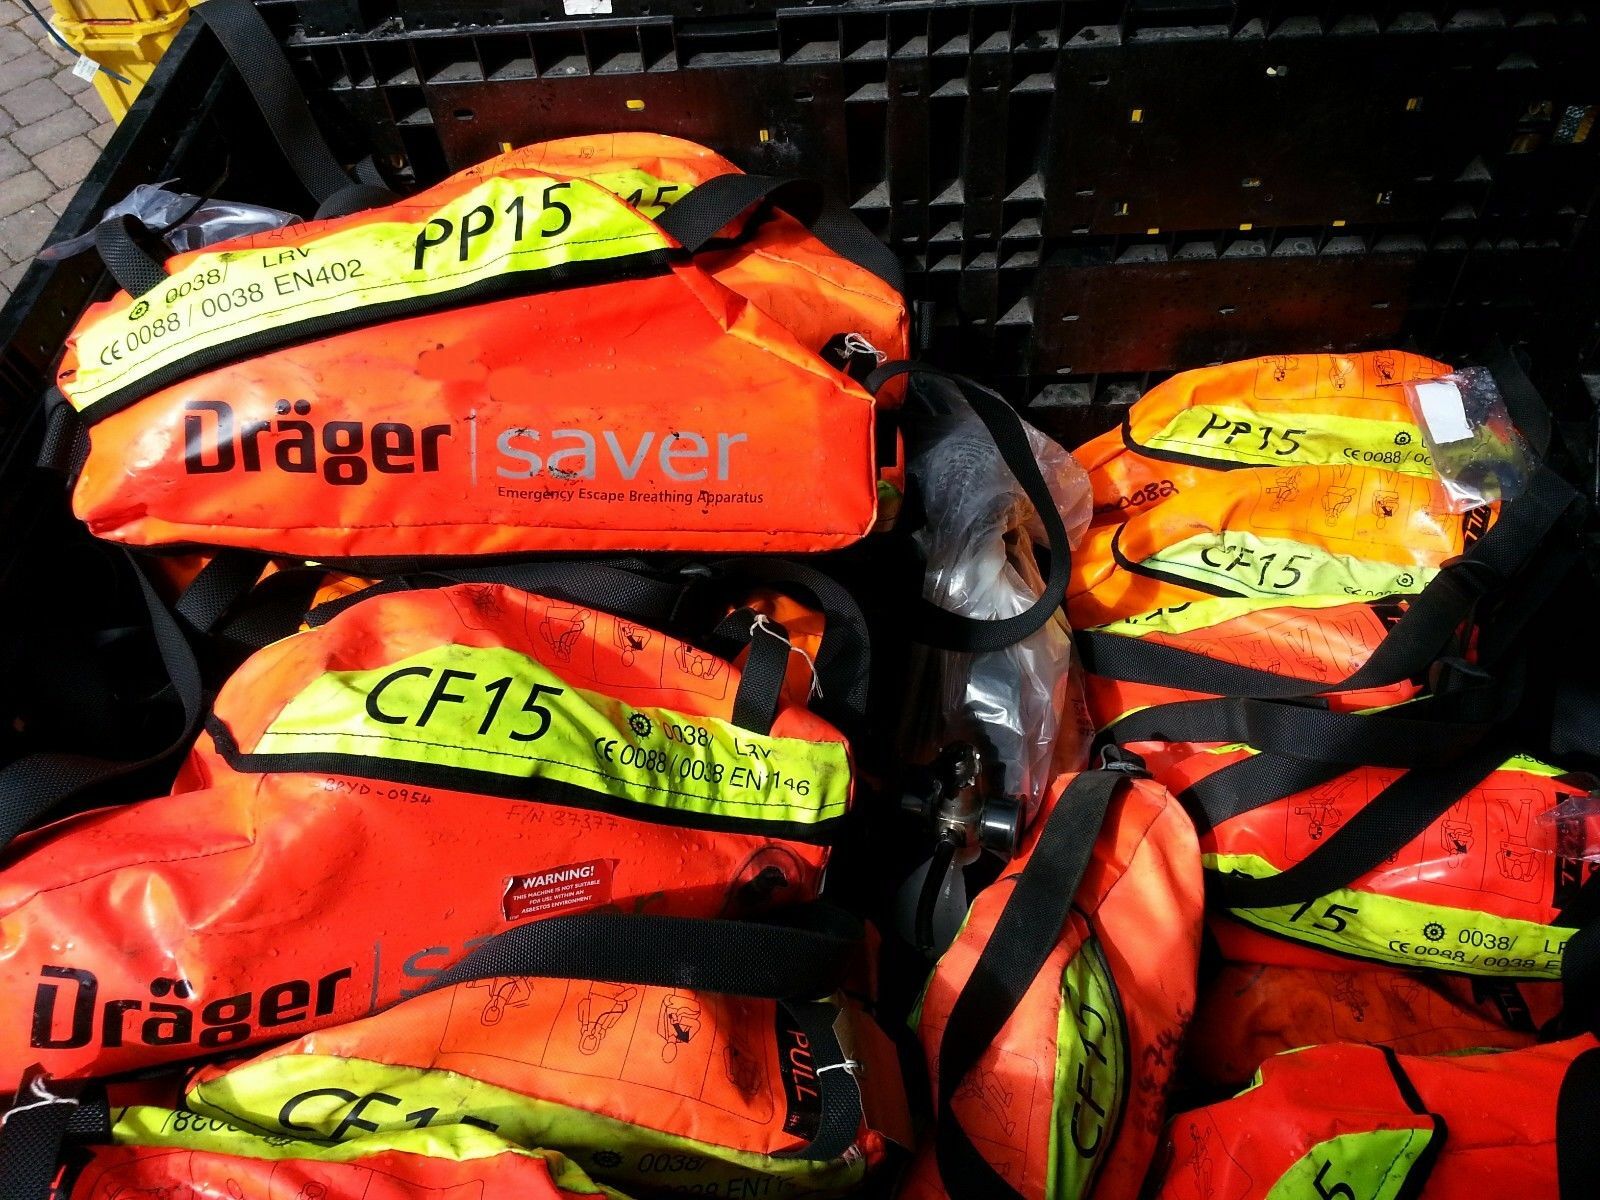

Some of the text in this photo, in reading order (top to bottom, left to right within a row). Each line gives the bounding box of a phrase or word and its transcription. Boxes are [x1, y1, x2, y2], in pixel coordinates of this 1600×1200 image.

[414, 183, 571, 270] PP15
[263, 247, 314, 269] LRV
[201, 282, 265, 319] 0038
[274, 258, 365, 297] EN402
[185, 398, 748, 486] Dräger saver
[1197, 412, 1307, 456] PP15
[498, 486, 764, 506] Emergency Escape Breathing Apparatus
[1201, 545, 1313, 589] CF15
[365, 666, 565, 742] CF15
[522, 866, 595, 889] WARNING!
[528, 889, 554, 898] MACHINE
[574, 879, 600, 888] SUITABLE
[553, 892, 575, 900] WITHIN
[521, 895, 592, 914] ASBESTOS ENVIRONMENT
[1458, 928, 1519, 951] 0038/
[30, 963, 353, 1049] Dräger
[786, 1028, 818, 1102] PULL
